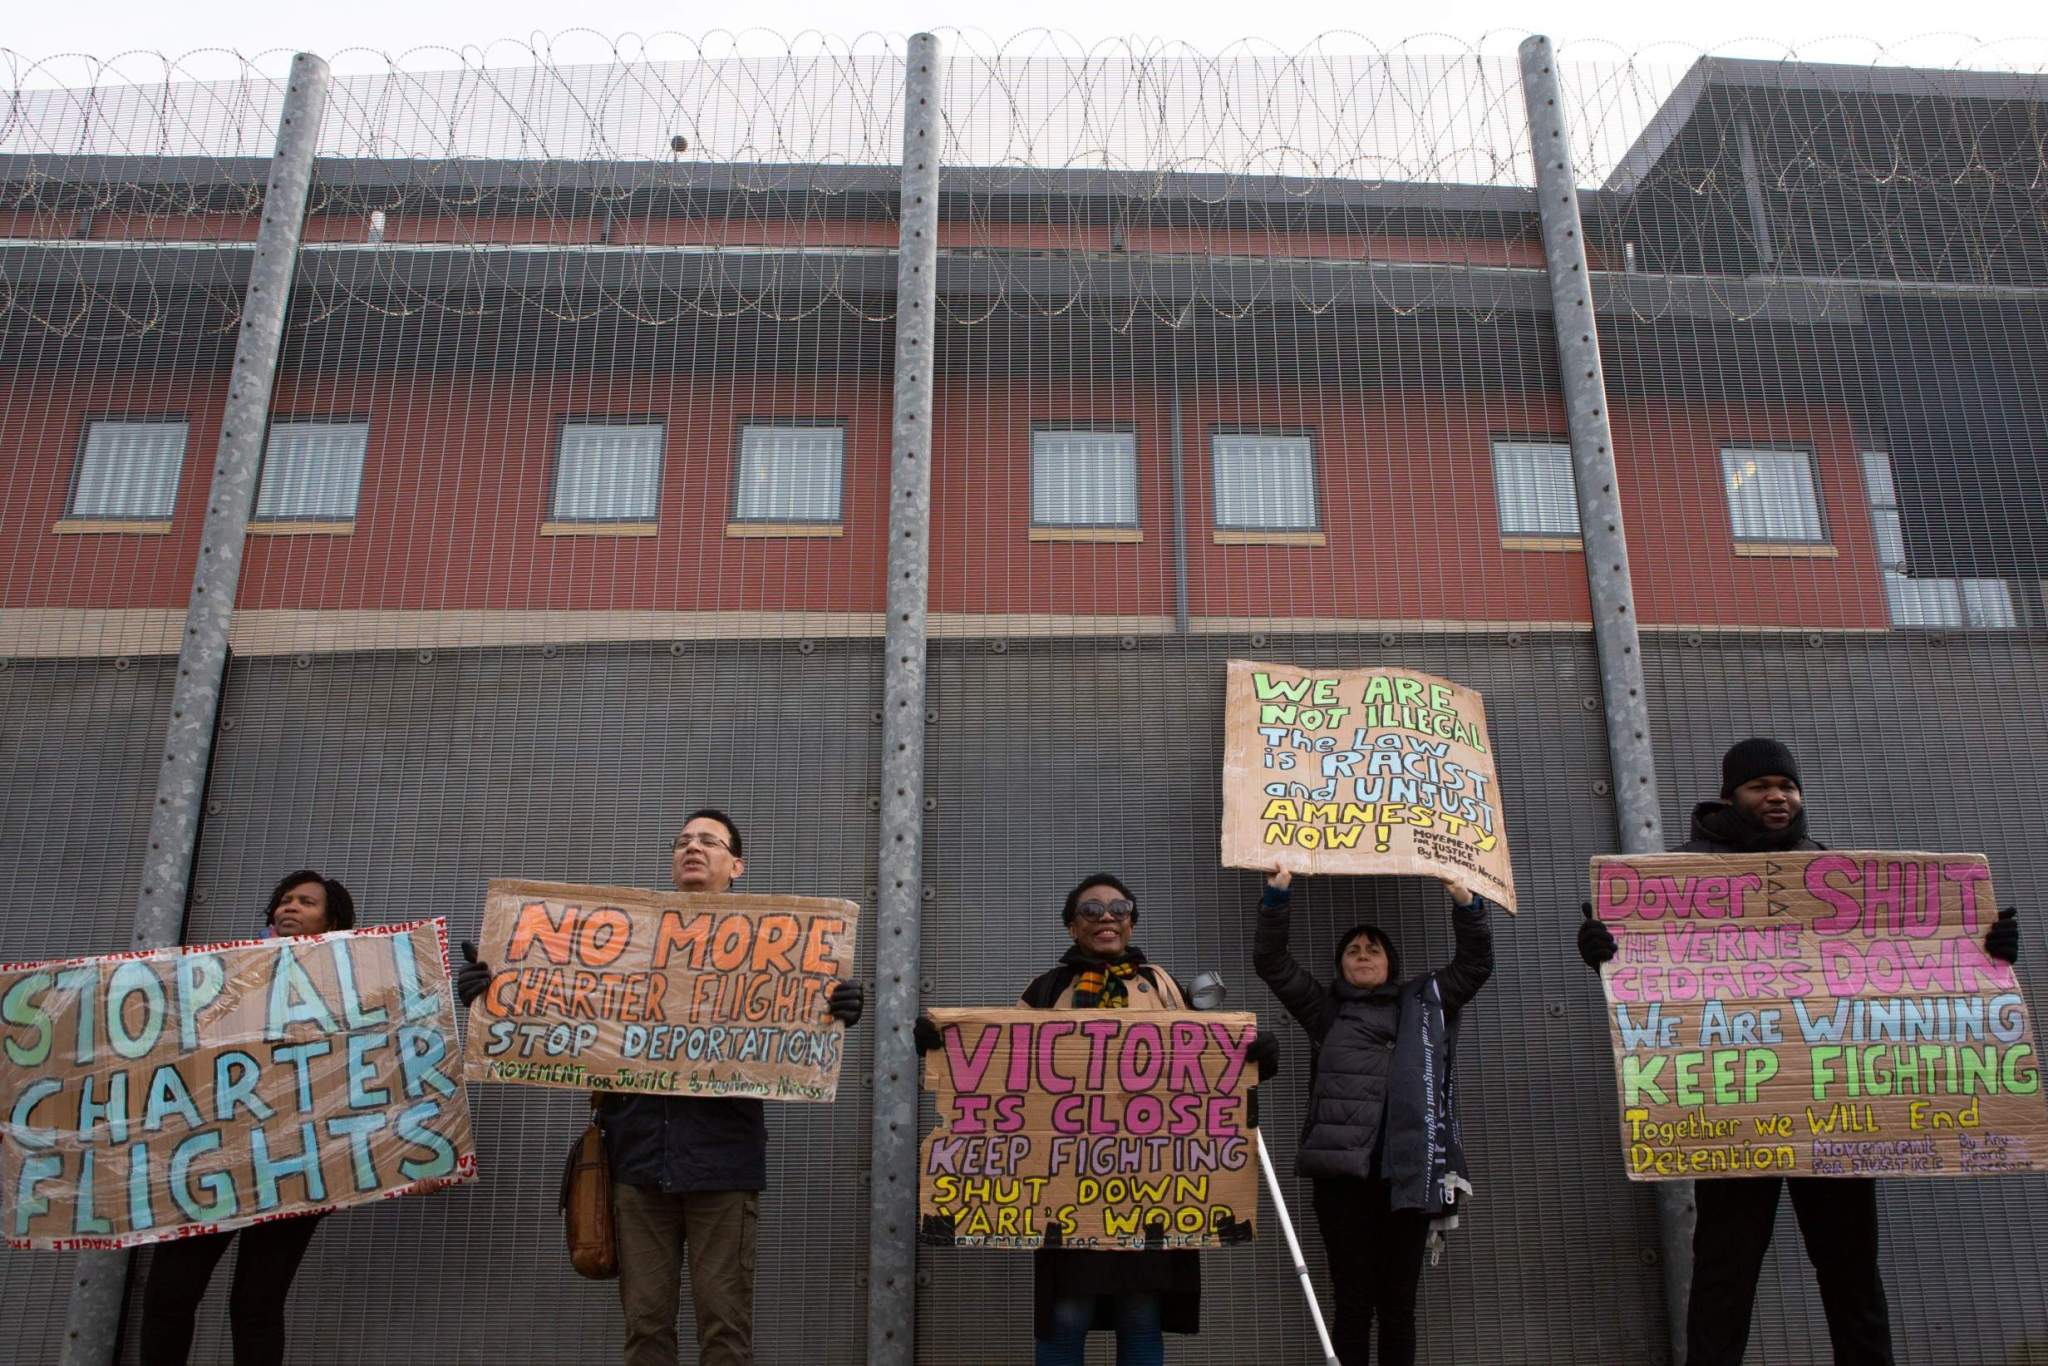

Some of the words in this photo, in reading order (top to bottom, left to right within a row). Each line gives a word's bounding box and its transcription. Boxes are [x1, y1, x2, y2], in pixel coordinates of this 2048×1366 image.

[1251, 671, 1341, 706] WE
[1362, 675, 1458, 717] ARE
[1258, 727, 1337, 753] The
[1351, 728, 1450, 758] Law
[1259, 703, 1350, 731] NOT
[1365, 703, 1487, 754] ILLEGAL
[1263, 747, 1297, 770] is
[1321, 749, 1489, 802] RACIST
[1261, 798, 1497, 853] AMNESTY
[1263, 776, 1339, 802] and
[1354, 776, 1494, 834] UNJUST
[1413, 828, 1480, 856] MOVEMENT
[1418, 847, 1431, 859] By
[1432, 842, 1475, 860] JUSTICE
[1599, 862, 1762, 921] Dover
[1803, 855, 1989, 939] SHUT
[505, 900, 633, 969] NO
[652, 908, 847, 976] MORE
[1606, 924, 1660, 964] THE
[1662, 920, 1804, 964] VERNE
[1820, 936, 2015, 999] DOWN
[1, 951, 225, 1067] STOP
[264, 933, 441, 1043] ALL
[484, 968, 667, 1022] CHARTER
[1612, 961, 1815, 1003] CEDARS
[485, 1018, 598, 1059] STOP
[621, 1023, 841, 1067] DEPORTATIONS
[1422, 1026, 1434, 1047] and
[1792, 993, 2026, 1048] WINNING
[486, 1061, 586, 1087] MOVEMENT
[616, 1068, 681, 1091] JUSTICE
[942, 1019, 1257, 1095] VICTORY
[1422, 1047, 1436, 1106] immigrant
[1622, 1047, 1780, 1109] KEEP
[1809, 1042, 2039, 1102] FIGHTING
[9, 1025, 458, 1150] CHARTER
[951, 1094, 1025, 1134] IS
[1051, 1093, 1242, 1136] CLOSE
[1425, 1107, 1437, 1140] rights
[1624, 1107, 1742, 1145] Together
[1755, 1112, 1796, 1137] we
[1806, 1104, 1881, 1137] WILL
[1909, 1096, 1981, 1132] End
[14, 1101, 460, 1237] FLIGHTS
[927, 1135, 1031, 1176] KEEP
[1049, 1136, 1248, 1177] FIGHTING
[1630, 1142, 1796, 1175] Detention
[931, 1175, 1049, 1205] SHUT
[1077, 1175, 1209, 1205] DOWN
[956, 1236, 1041, 1248] OVEMEN
[1117, 1235, 1212, 1248] JUTICE
[1103, 1204, 1235, 1237] WOOD
